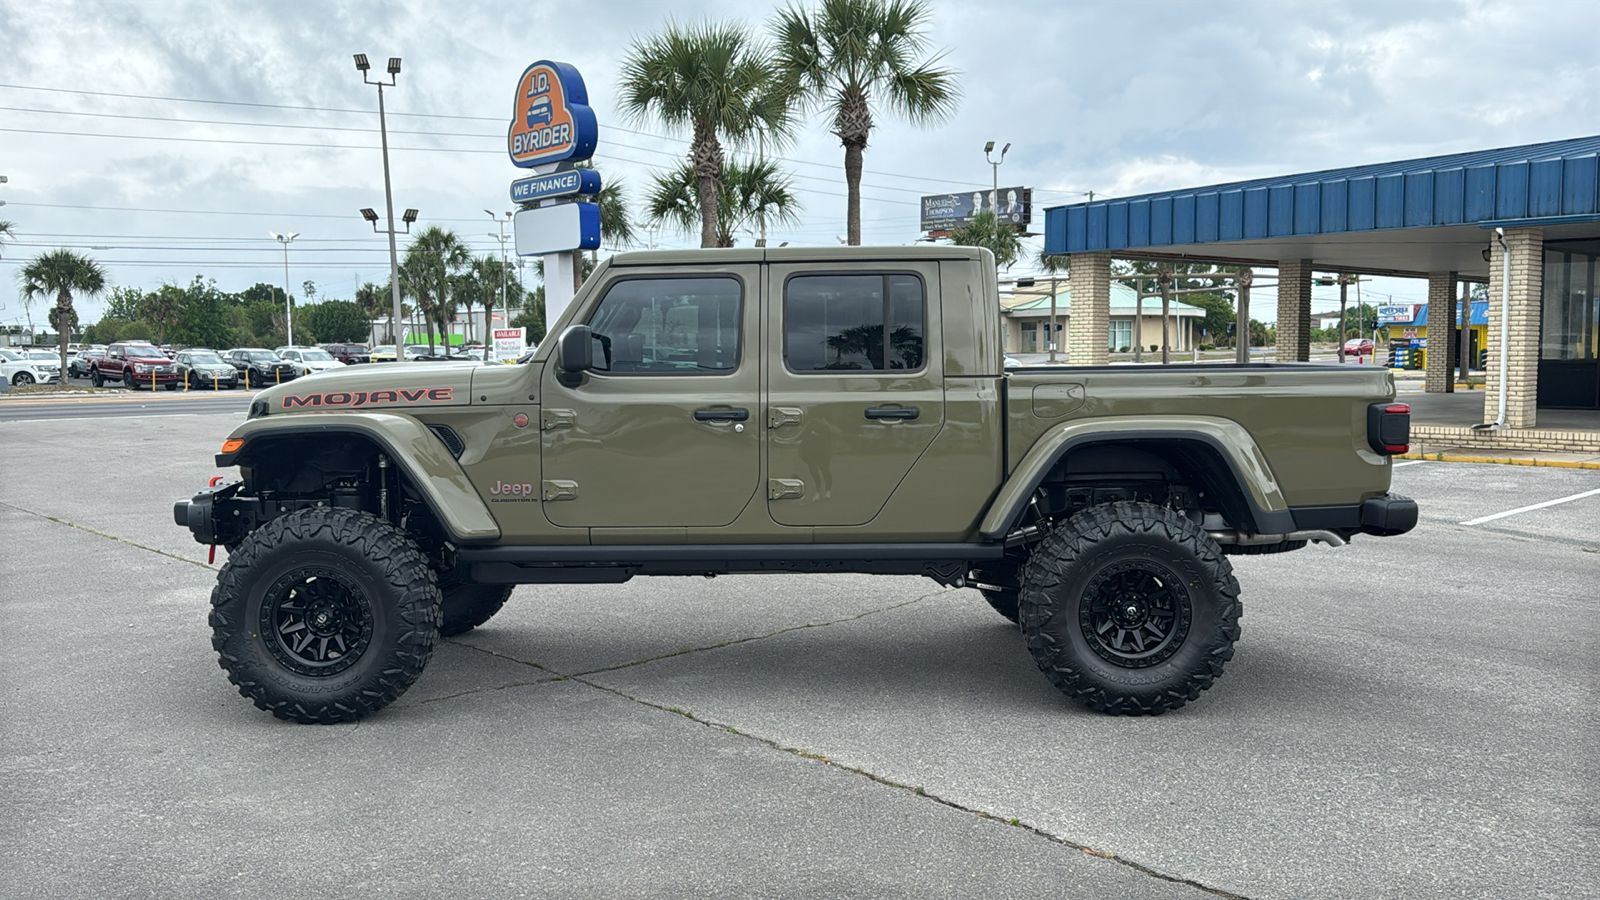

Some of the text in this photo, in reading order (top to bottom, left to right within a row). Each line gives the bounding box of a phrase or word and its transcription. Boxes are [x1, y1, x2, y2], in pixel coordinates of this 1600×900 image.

[528, 73, 550, 96] J.D.
[513, 123, 571, 154] BYRIDER
[514, 175, 577, 197] WE FINANCE!
[282, 388, 453, 408] MOJAVE
[490, 480, 532, 497] Jeep
